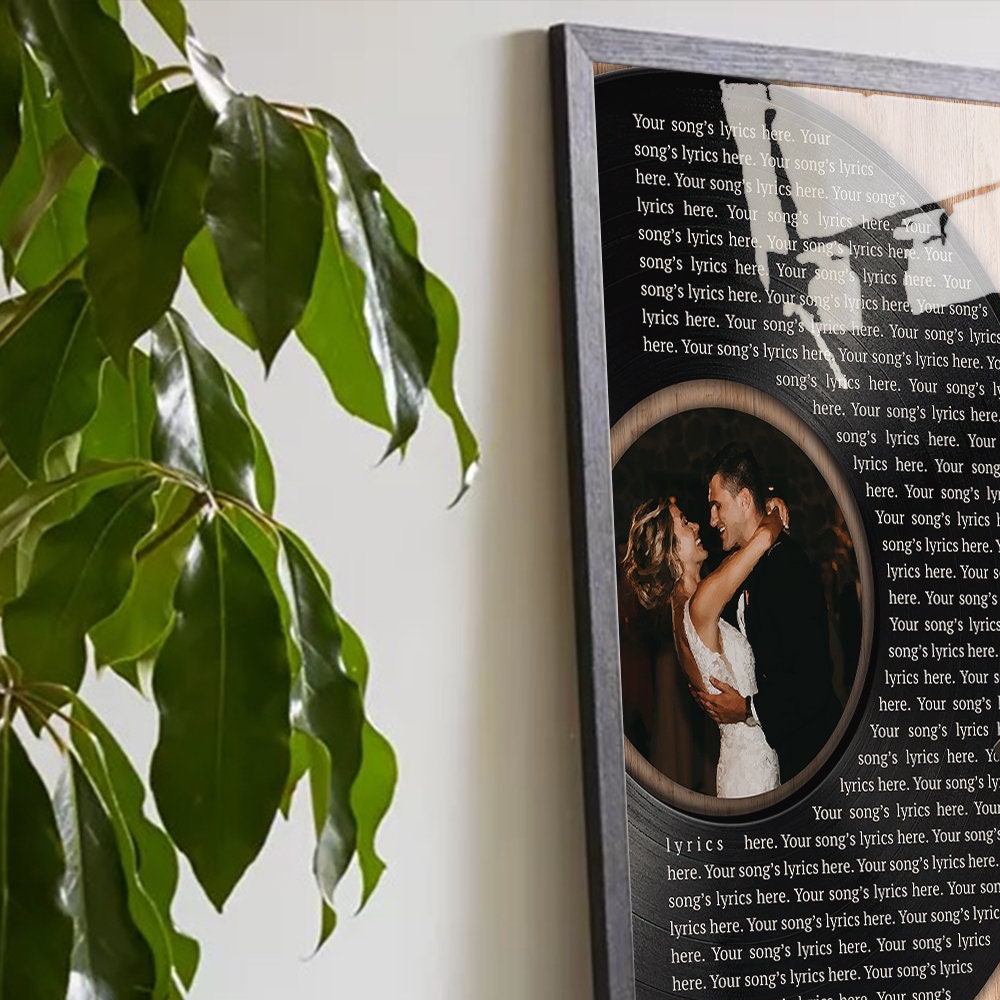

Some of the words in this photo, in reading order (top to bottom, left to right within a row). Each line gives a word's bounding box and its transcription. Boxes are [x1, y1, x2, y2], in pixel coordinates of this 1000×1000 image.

[633, 113, 665, 131] Your
[671, 121, 713, 137] song's
[720, 120, 755, 139] lyrics
[762, 124, 795, 142] here.
[800, 128, 830, 145] Your
[639, 257, 682, 273] song's
[691, 256, 727, 275] lyrics
[735, 259, 768, 276] here.
[776, 262, 806, 279] Your
[814, 268, 854, 284] song's
[863, 267, 896, 286] lyrics
[903, 270, 935, 287] here.
[943, 273, 971, 289] Your
[641, 308, 678, 328] lyrics
[685, 311, 719, 328] here.
[725, 314, 755, 330] Your
[763, 319, 804, 335] song's
[810, 318, 845, 337] lyrics
[852, 320, 883, 337] here.
[889, 323, 918, 339] Your
[924, 328, 963, 344] song's
[643, 336, 677, 353] here.
[681, 339, 712, 355] Your
[717, 343, 758, 360] song's
[763, 342, 797, 361] lyrics
[802, 344, 834, 361] here.
[838, 347, 867, 363] Your
[872, 351, 911, 367] song's
[915, 350, 948, 369] lyrics
[952, 352, 982, 368] here.
[812, 399, 845, 416] here.
[850, 402, 881, 417] Your
[887, 405, 926, 422] song's
[932, 405, 965, 423] lyrics
[970, 406, 1000, 422] here.
[836, 430, 877, 447] song's
[886, 429, 920, 448] lyrics
[928, 431, 959, 447] here.
[967, 433, 996, 448] Your
[853, 455, 887, 474] lyrics
[895, 456, 927, 472] here.
[934, 458, 964, 473] Your
[875, 510, 905, 525] Your
[911, 512, 951, 529] song's
[957, 511, 990, 529] lyrics
[882, 538, 922, 555] song's
[925, 537, 959, 555] lyrics
[961, 537, 993, 553] here.
[887, 563, 921, 581] lyrics
[925, 563, 956, 579] here.
[960, 565, 989, 579] Your
[889, 617, 919, 631] Your
[925, 618, 964, 635] song's
[889, 644, 928, 661] song's
[931, 643, 965, 661] lyrics
[967, 643, 998, 657] here.
[812, 806, 843, 820] Your
[850, 804, 890, 822] song's
[896, 802, 930, 821] lyrics
[936, 802, 968, 816] here.
[669, 893, 712, 911] song's
[716, 890, 752, 910] lyrics
[756, 889, 790, 904] here.
[794, 888, 824, 902] Your
[829, 886, 870, 903] song's
[873, 883, 908, 902] lyrics
[912, 882, 943, 897] here.
[947, 881, 976, 895] Your
[671, 948, 705, 964] here.
[711, 946, 743, 961] Your
[749, 944, 791, 961] song's
[797, 941, 832, 960] lyrics
[838, 939, 871, 954] here.
[876, 938, 906, 952] Your
[913, 935, 952, 952] song's
[957, 932, 991, 951] lyrics
[672, 976, 706, 991] here.
[709, 974, 741, 989] Your
[745, 971, 786, 989] song's
[790, 968, 825, 987] lyrics
[828, 967, 861, 982] here.
[863, 965, 893, 979] Your
[897, 962, 936, 980] song's
[940, 959, 973, 978] lyrics
